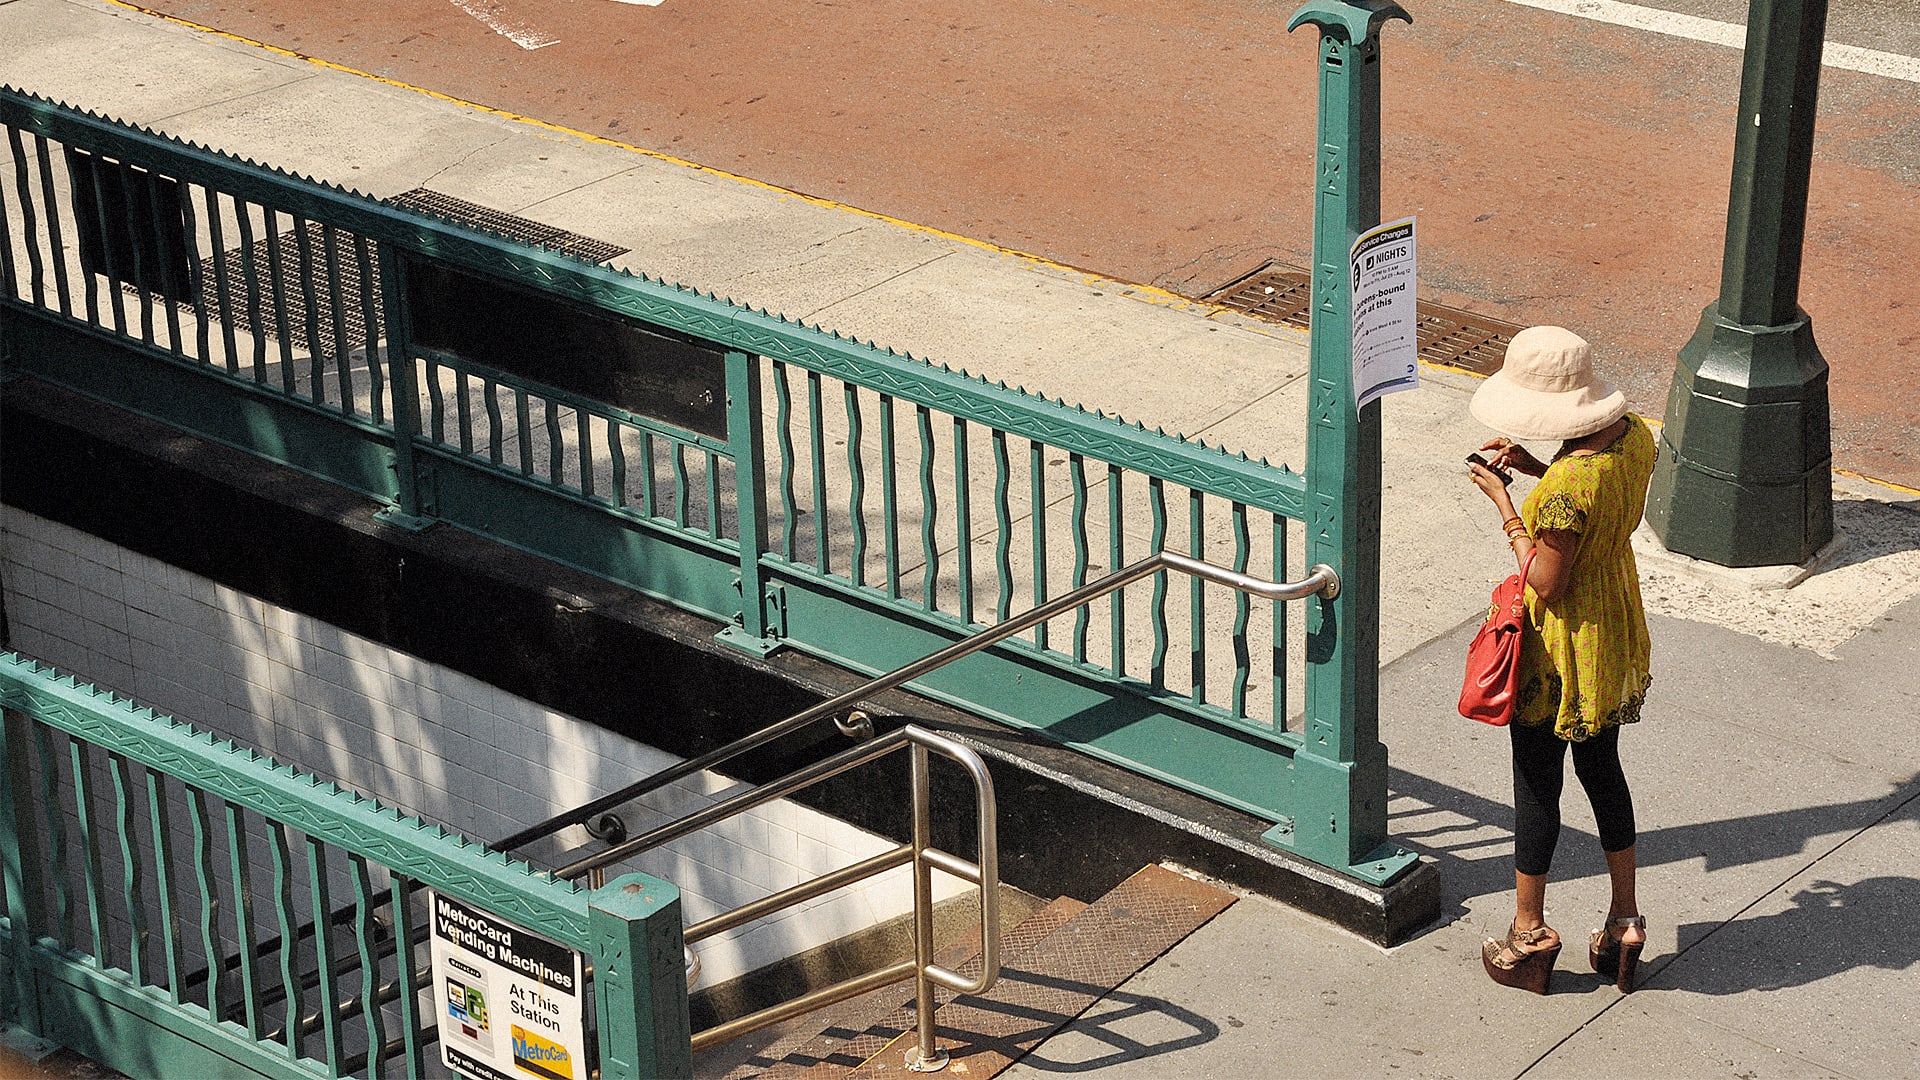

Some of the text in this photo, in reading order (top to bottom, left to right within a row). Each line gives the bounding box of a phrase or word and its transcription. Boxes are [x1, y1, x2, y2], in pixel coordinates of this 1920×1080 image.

[1380, 228, 1409, 242] Changes
[1376, 246, 1407, 265] NIGHTS
[1368, 303, 1375, 313] at
[1376, 298, 1392, 309] this
[438, 899, 512, 947] MetroCard
[438, 917, 573, 989] Vending Machines
[509, 983, 560, 1015] At This
[511, 1000, 560, 1032] Station
[512, 1037, 568, 1061] MetroCard
[449, 1051, 493, 1080] Pay with credit
